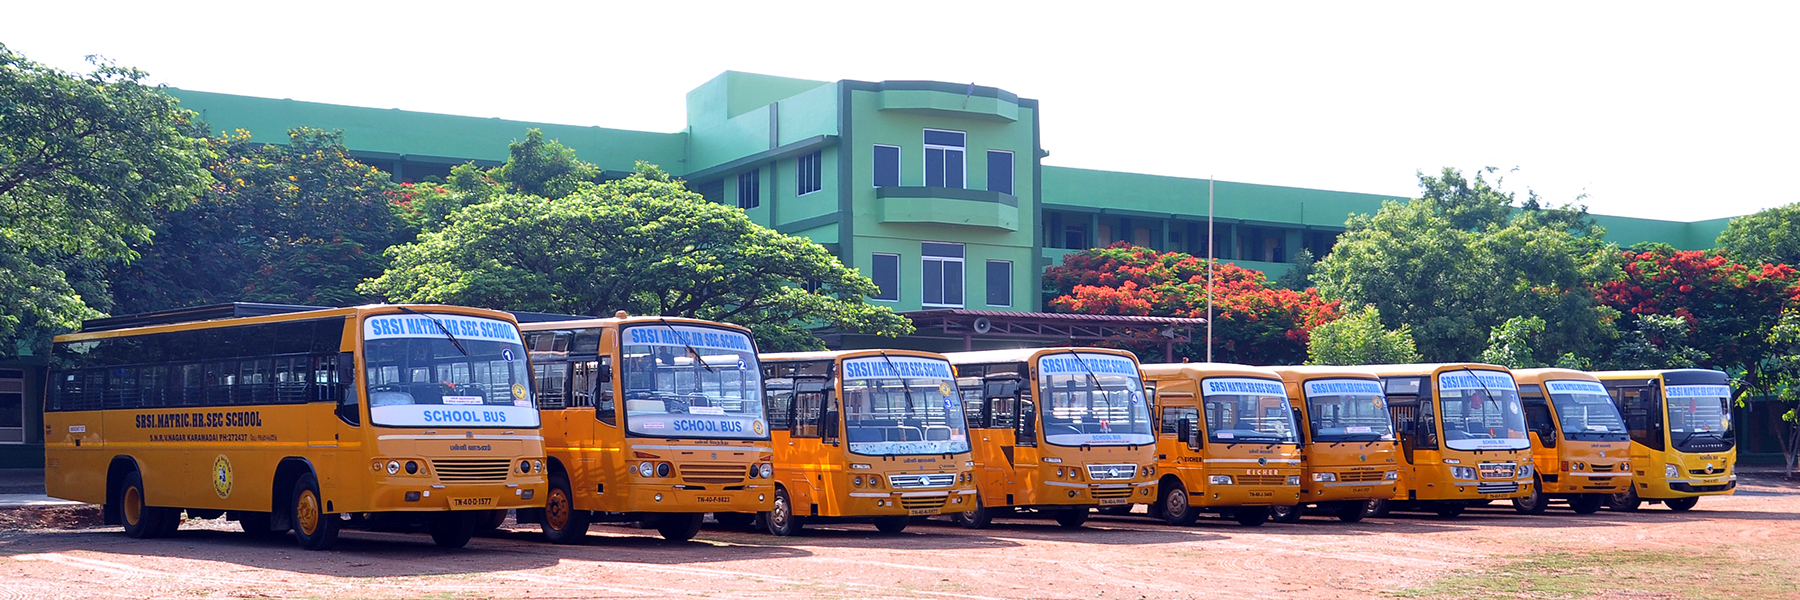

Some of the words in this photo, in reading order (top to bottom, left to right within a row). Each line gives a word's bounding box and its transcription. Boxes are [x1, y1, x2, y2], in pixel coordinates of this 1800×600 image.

[371, 318, 405, 335] SRSI
[406, 318, 445, 335] MATRIC
[445, 319, 460, 335] HR
[460, 320, 479, 336] SEC
[480, 321, 515, 340] SCHOOL
[631, 328, 659, 343] SRSI
[504, 351, 512, 361] 1
[739, 360, 746, 370] 2
[846, 362, 872, 377] SRSI
[900, 362, 910, 376] HR
[910, 362, 924, 377] SEC
[923, 363, 949, 378] SCHOOL
[1042, 358, 1066, 373] SRSI
[1101, 359, 1112, 373] SEC
[1209, 381, 1228, 392] SRSI
[1441, 376, 1460, 388] SRSI
[1668, 387, 1683, 396] SRSI
[945, 398, 951, 408] 3
[226, 411, 262, 427] SCHOOL
[423, 410, 480, 422] SCHOOL
[485, 411, 506, 422] BUS
[673, 420, 719, 432] SCHOOL
[720, 421, 742, 432] BUS
[187, 433, 218, 442] KARAMADAI
[219, 433, 248, 441] PH:272437
